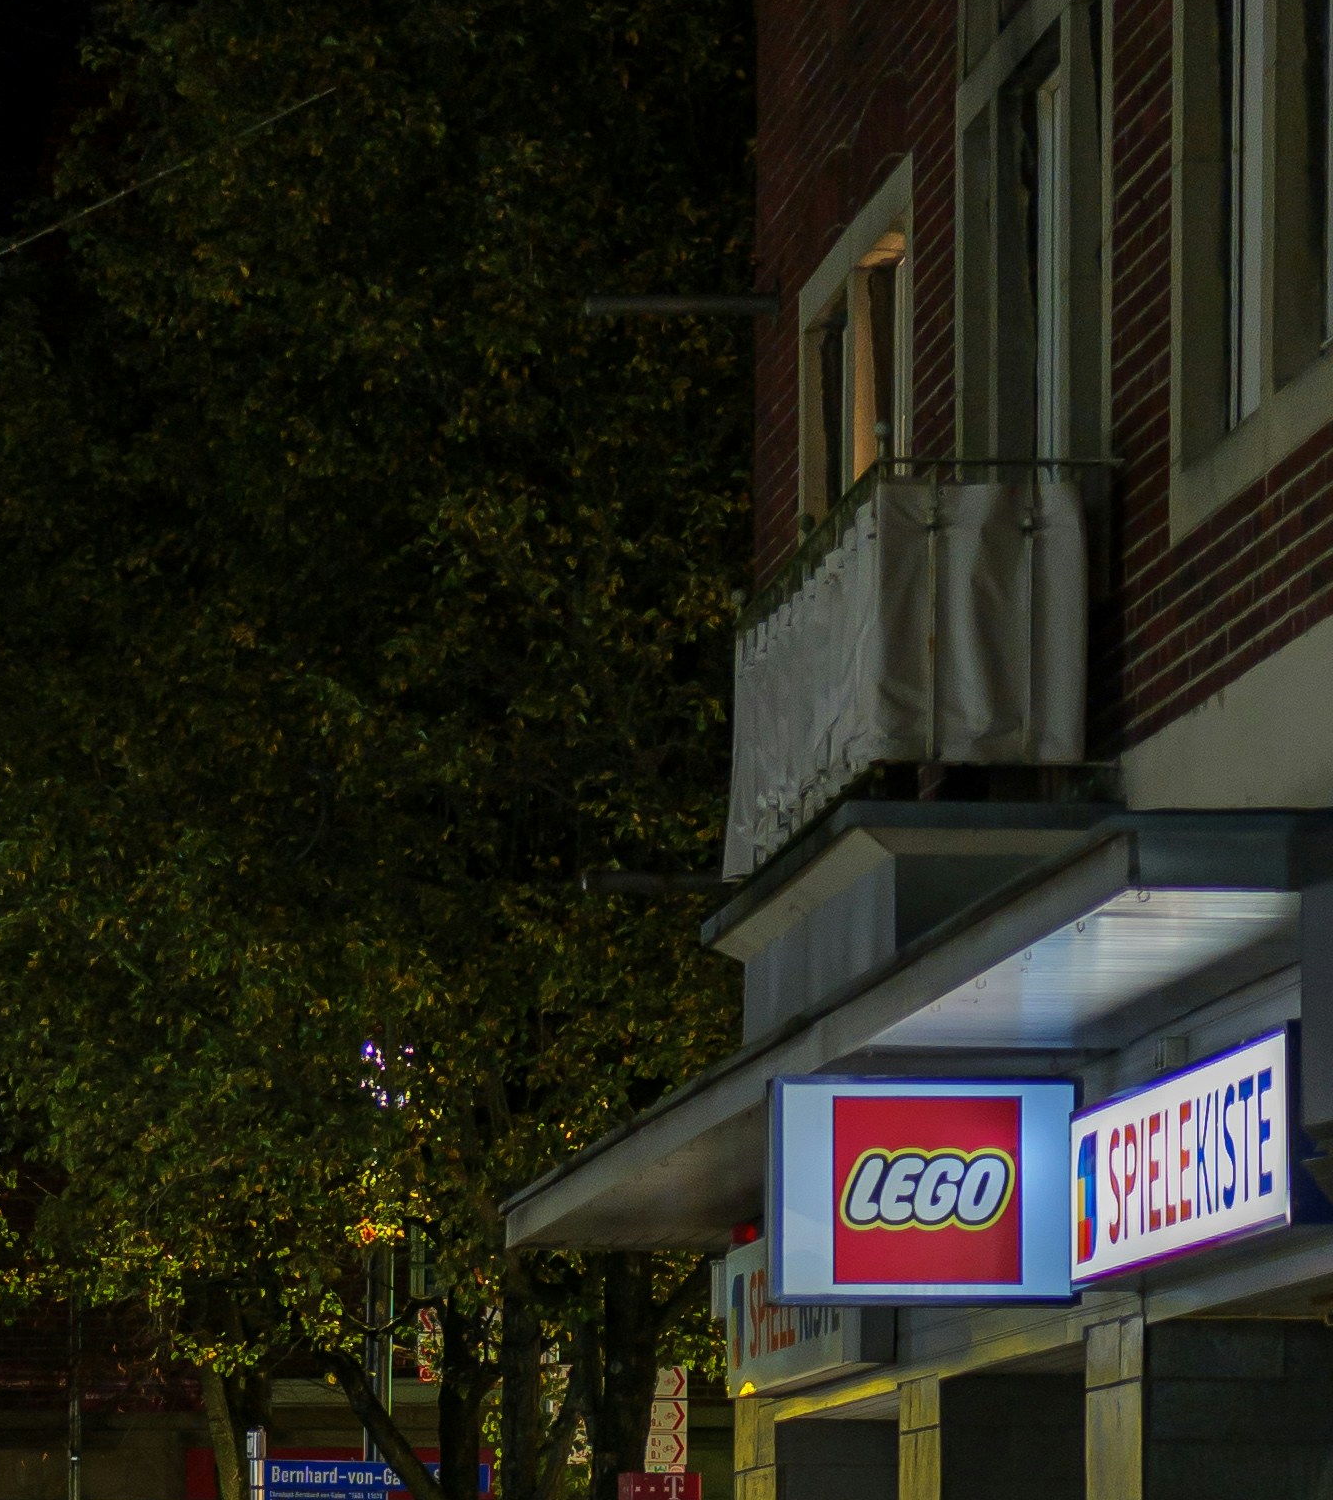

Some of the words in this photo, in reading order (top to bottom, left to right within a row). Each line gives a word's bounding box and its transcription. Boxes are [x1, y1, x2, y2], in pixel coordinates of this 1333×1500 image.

[845, 1153, 1009, 1226] LEGO
[1107, 1066, 1274, 1245] SPIELEKISTE
[271, 1465, 401, 1485] Bernhard-von-Ga
